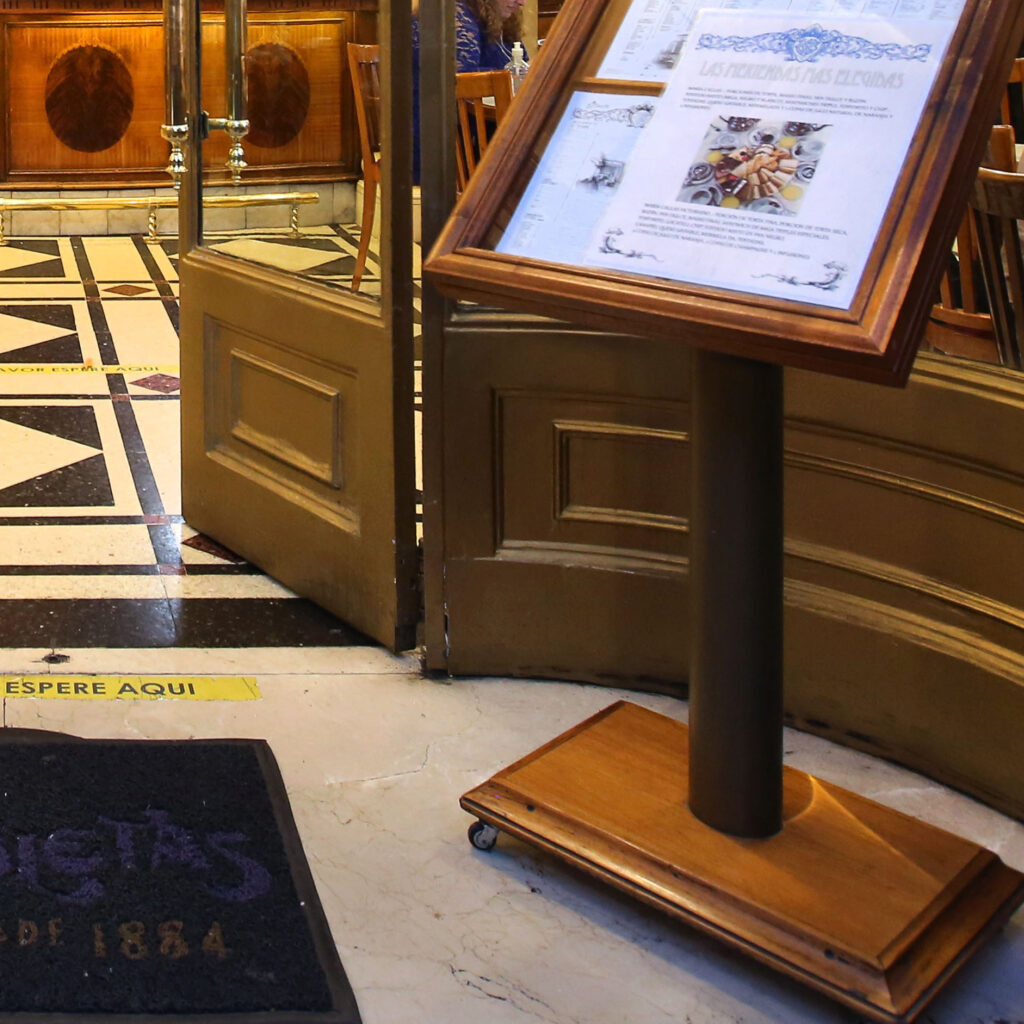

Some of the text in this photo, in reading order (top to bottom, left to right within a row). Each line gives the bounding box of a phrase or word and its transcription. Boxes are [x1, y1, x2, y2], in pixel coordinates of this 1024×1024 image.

[6, 681, 107, 695] ESPERE
[118, 681, 195, 695] AQUI
[93, 921, 230, 960] 1884
